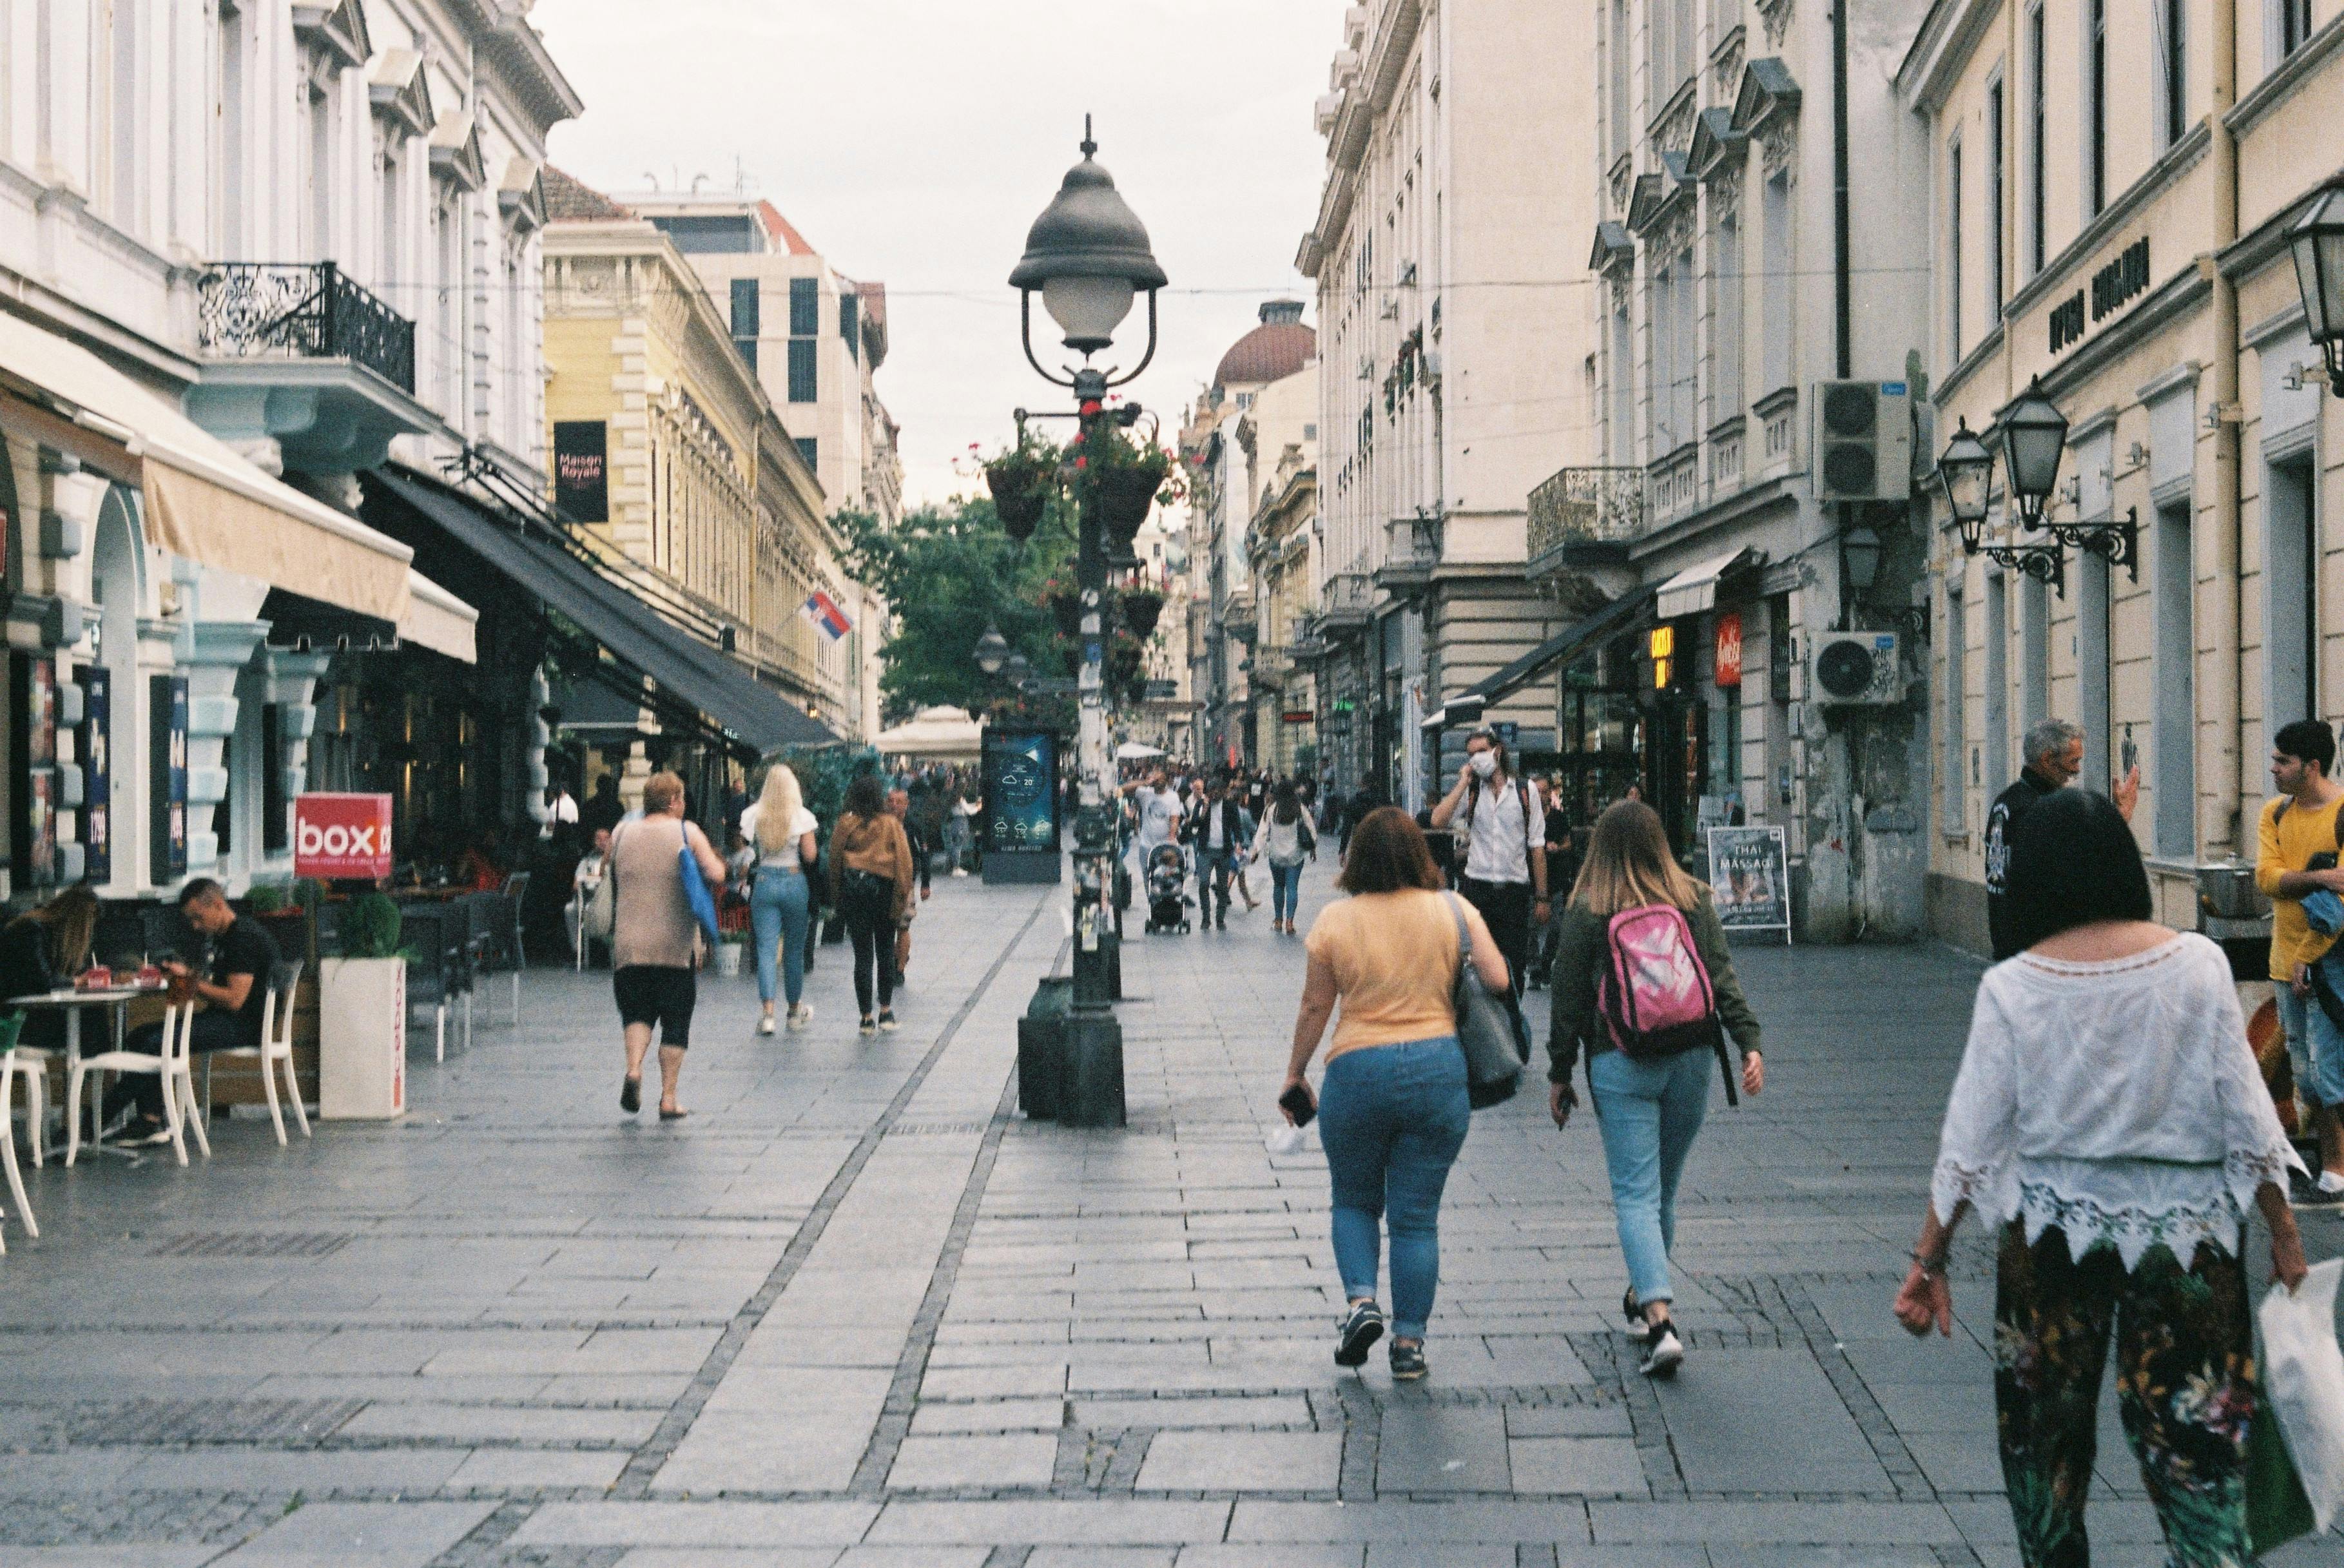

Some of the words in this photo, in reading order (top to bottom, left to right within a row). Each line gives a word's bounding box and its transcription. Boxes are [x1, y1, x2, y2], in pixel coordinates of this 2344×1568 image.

[559, 453, 602, 467] Maison
[561, 465, 601, 481] Royale
[298, 816, 375, 857] box
[1735, 844, 1761, 855] THAI
